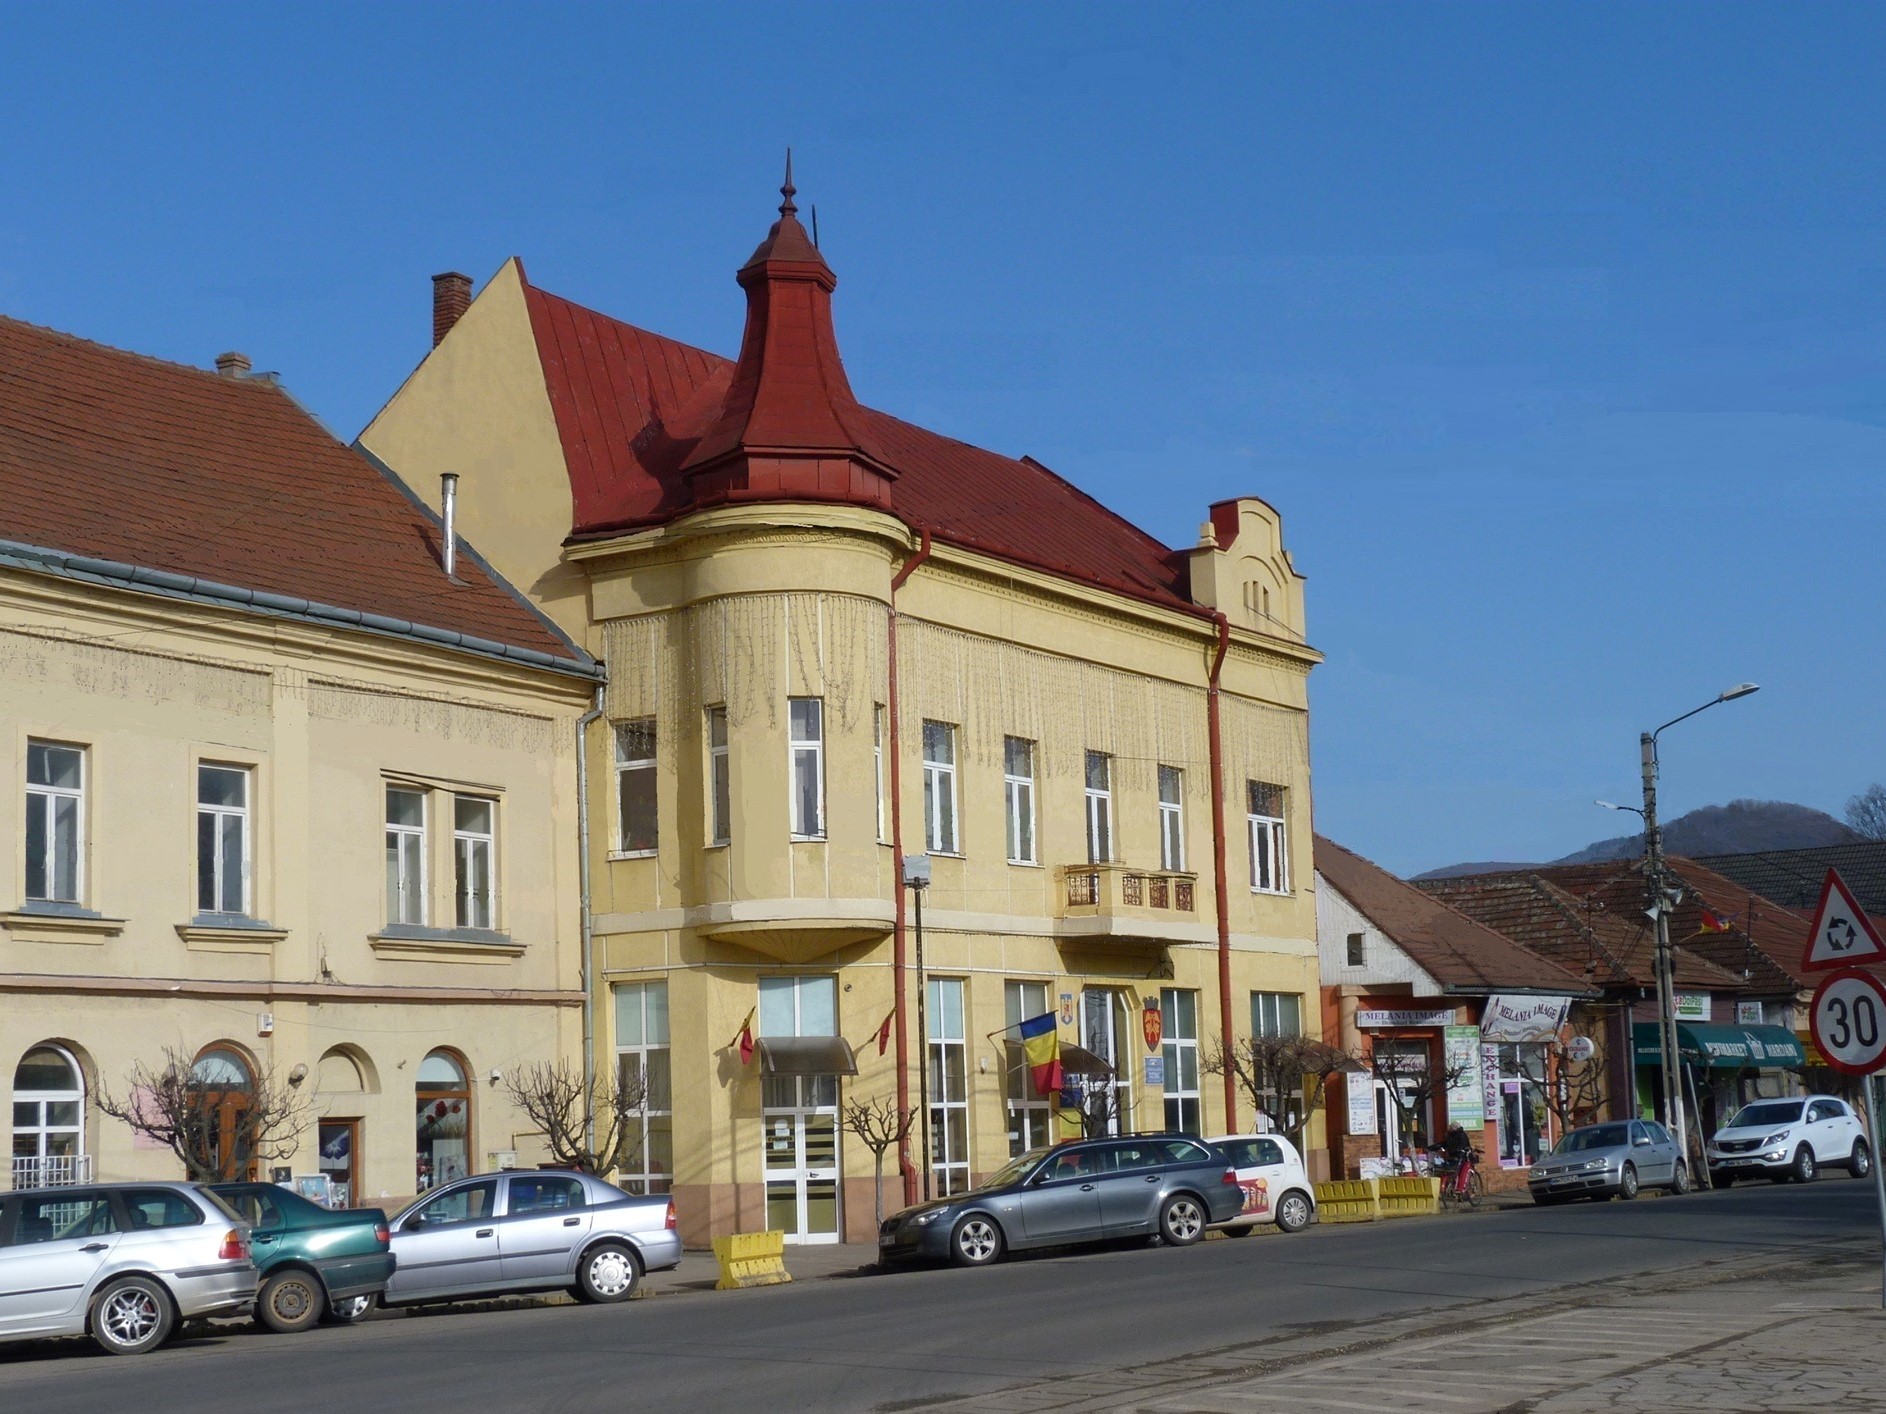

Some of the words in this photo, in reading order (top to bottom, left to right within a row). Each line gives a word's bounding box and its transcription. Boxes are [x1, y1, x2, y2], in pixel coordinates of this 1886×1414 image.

[1365, 1012, 1412, 1020] MELANIA
[1415, 1011, 1448, 1020] IMAGE
[1499, 1005, 1531, 1021] MELANIA
[1533, 1003, 1557, 1020] IMAGE
[1827, 995, 1878, 1048] 30
[1485, 1047, 1497, 1116] EXCHANGE
